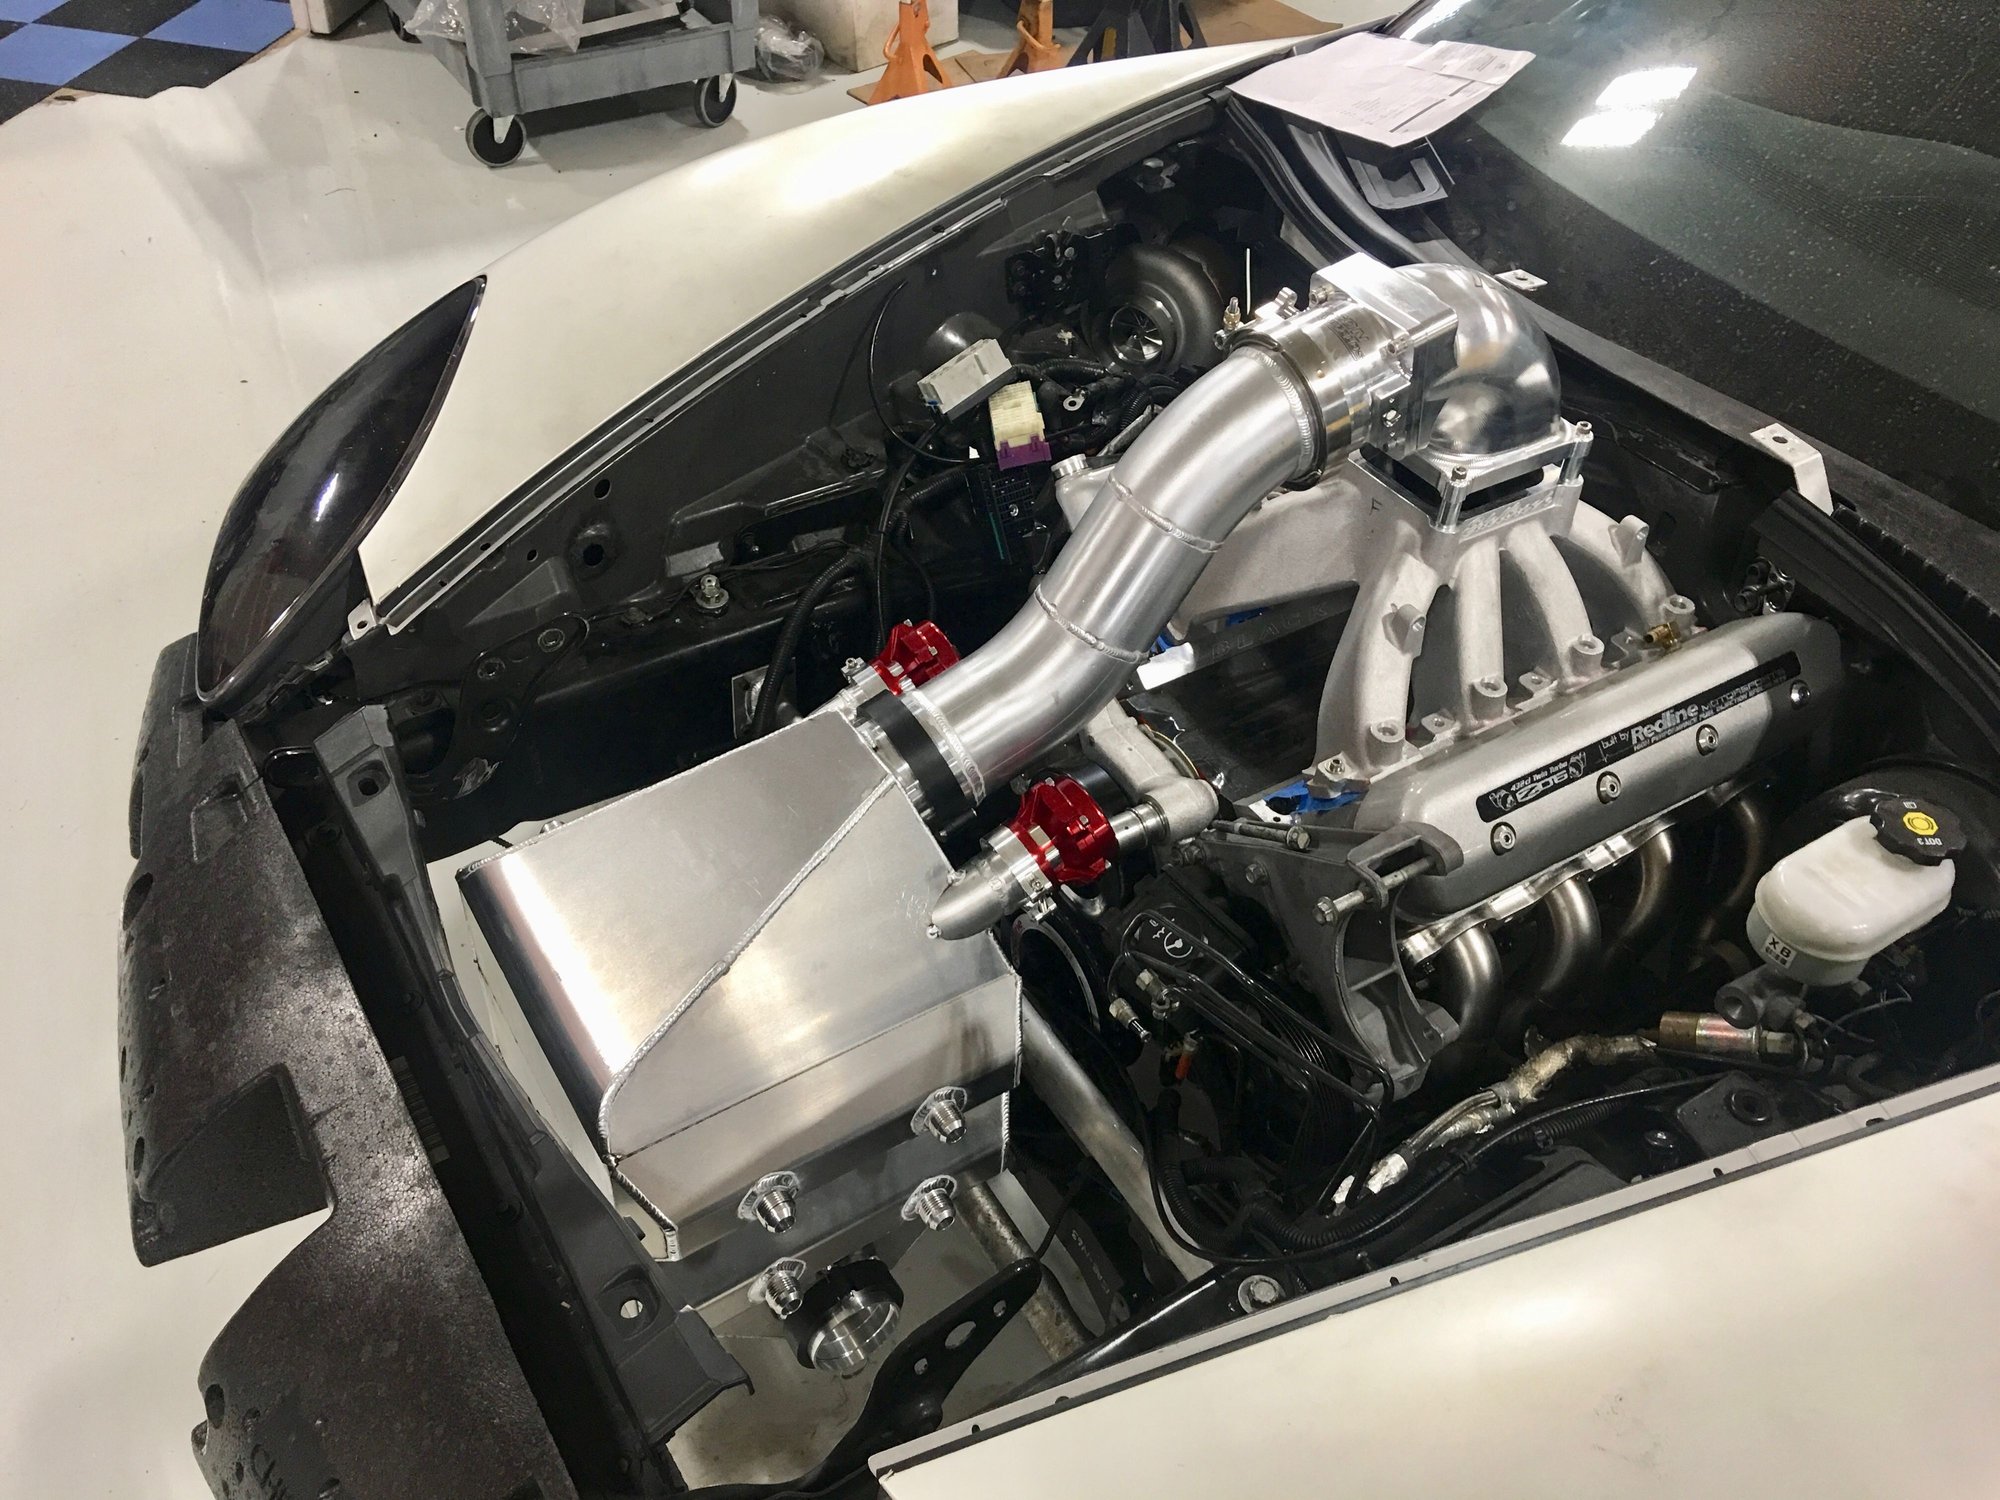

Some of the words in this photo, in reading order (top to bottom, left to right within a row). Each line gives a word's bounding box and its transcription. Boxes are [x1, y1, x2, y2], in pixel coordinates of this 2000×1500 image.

[1630, 703, 1699, 746] Redline
[1601, 732, 1618, 750] built
[1619, 730, 1630, 742] by
[1515, 769, 1568, 803] Z06
[1916, 837, 1925, 845] 3
[1924, 837, 1943, 846] DOT
